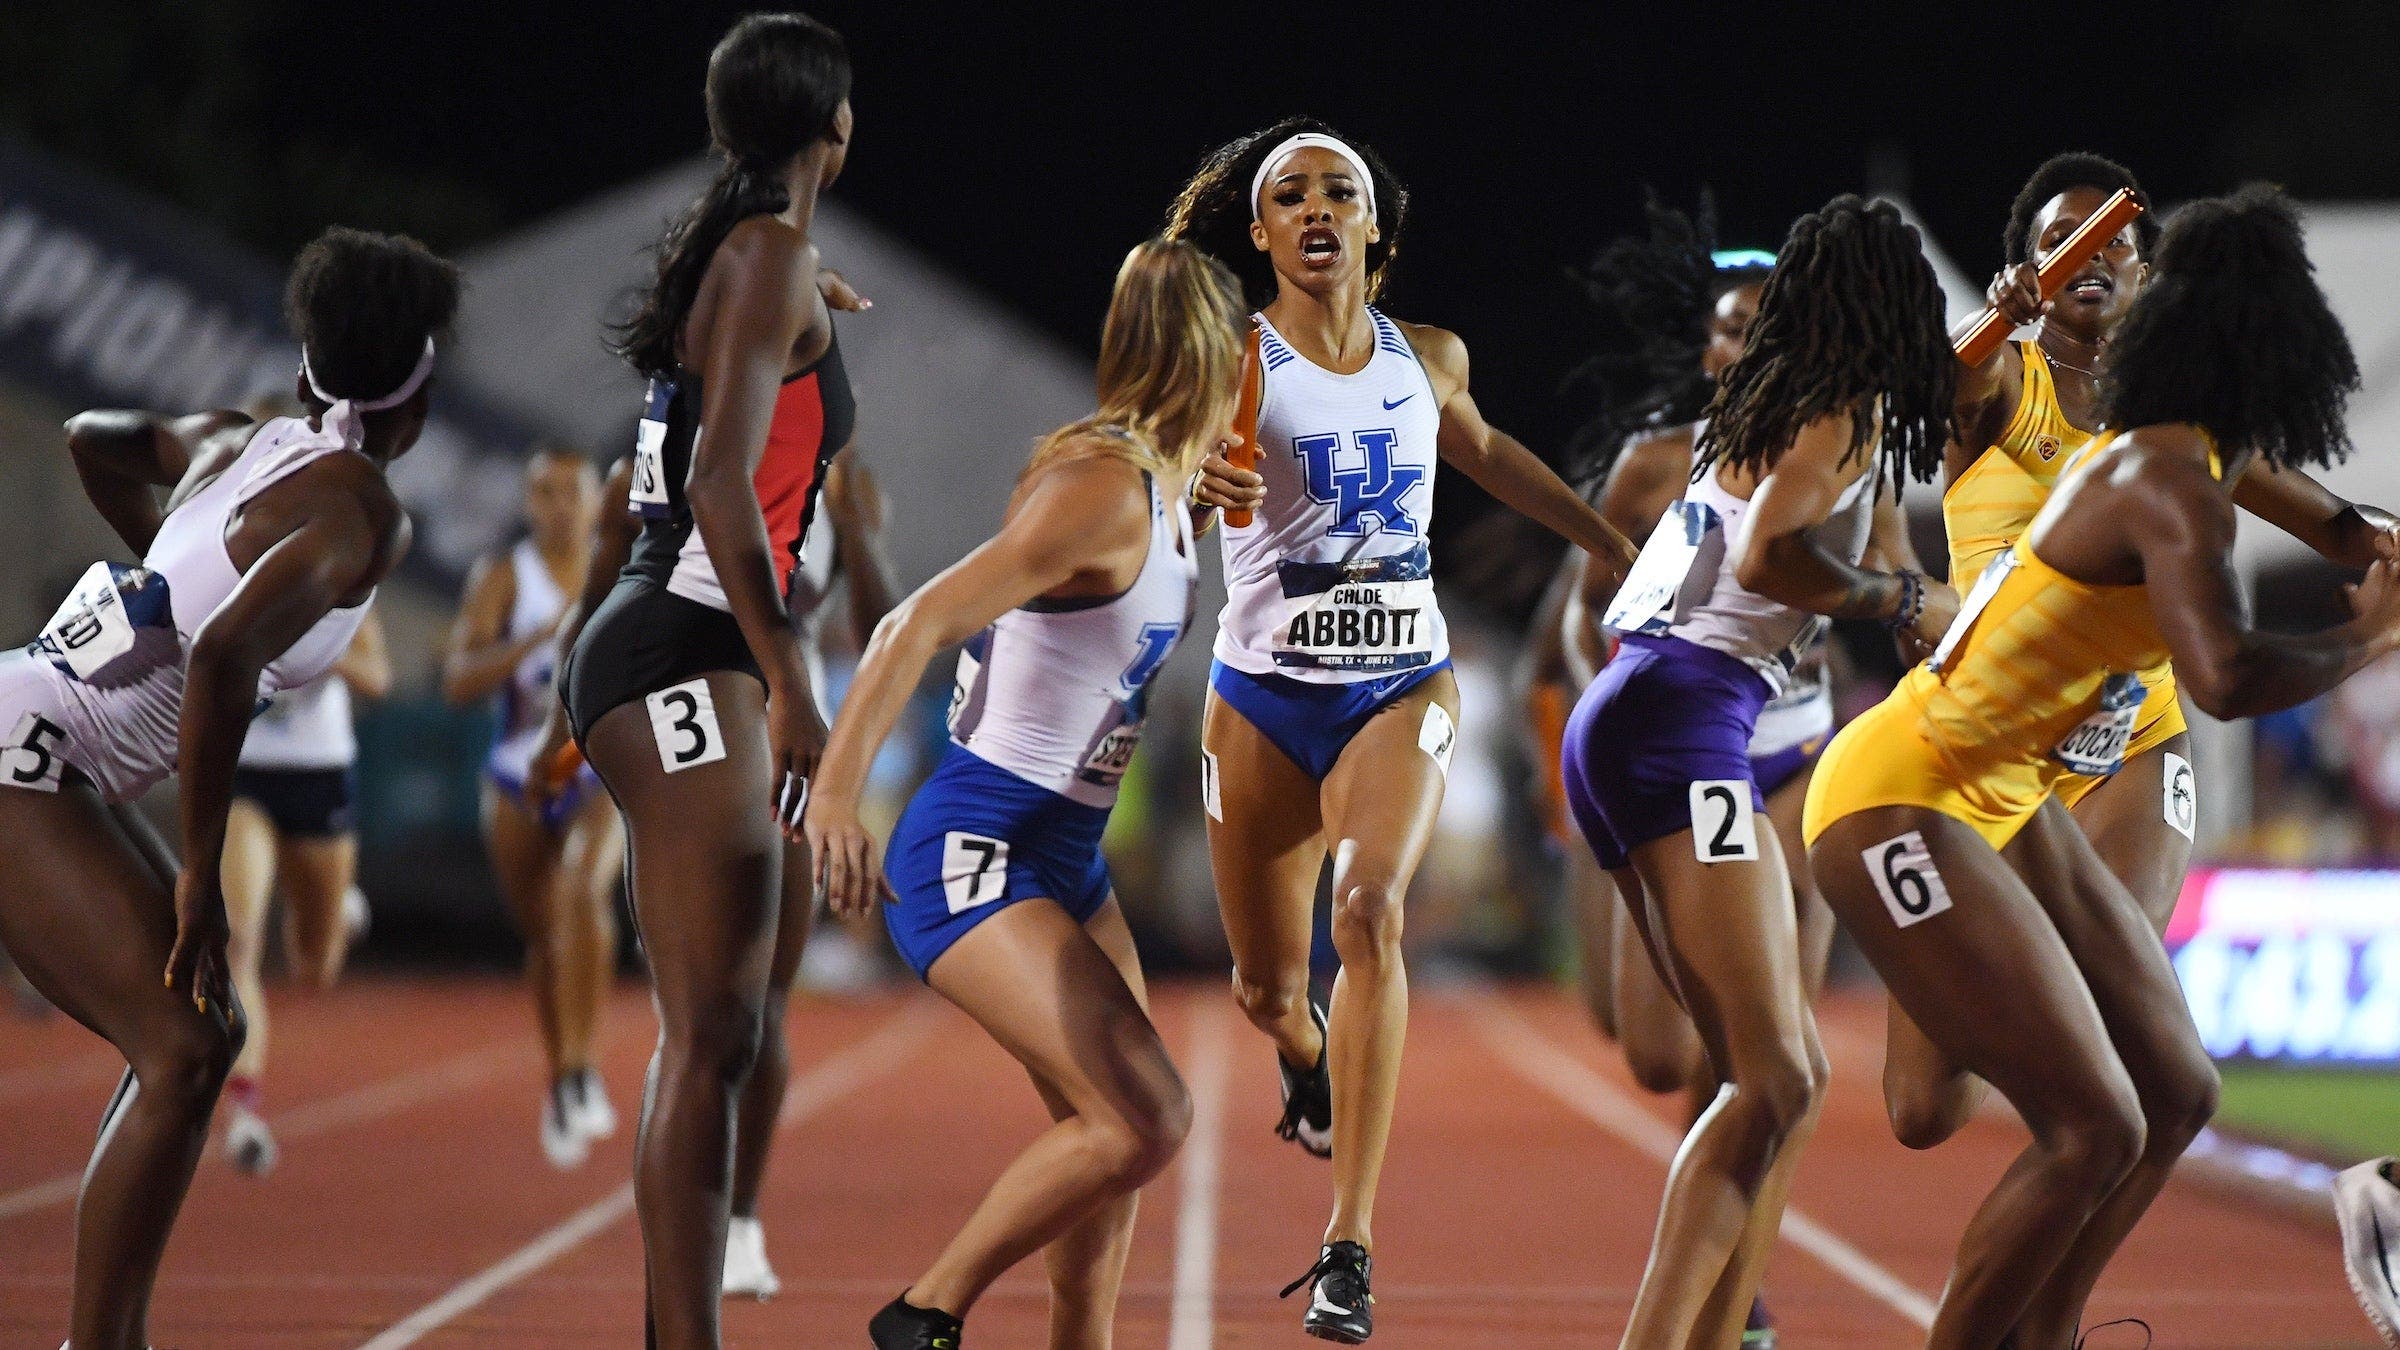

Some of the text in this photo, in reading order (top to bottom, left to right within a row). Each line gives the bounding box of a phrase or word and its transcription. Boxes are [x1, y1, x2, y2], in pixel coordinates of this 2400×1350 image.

[1292, 428, 1425, 538] UK
[1286, 607, 1422, 648] ABBOTT
[1333, 588, 1384, 605] CHLOE
[12, 717, 67, 783] 5
[662, 689, 706, 763] 3
[1703, 786, 1744, 856] 2
[2173, 764, 2192, 831] 6
[961, 839, 996, 902] 7
[1883, 842, 1931, 915] 6
